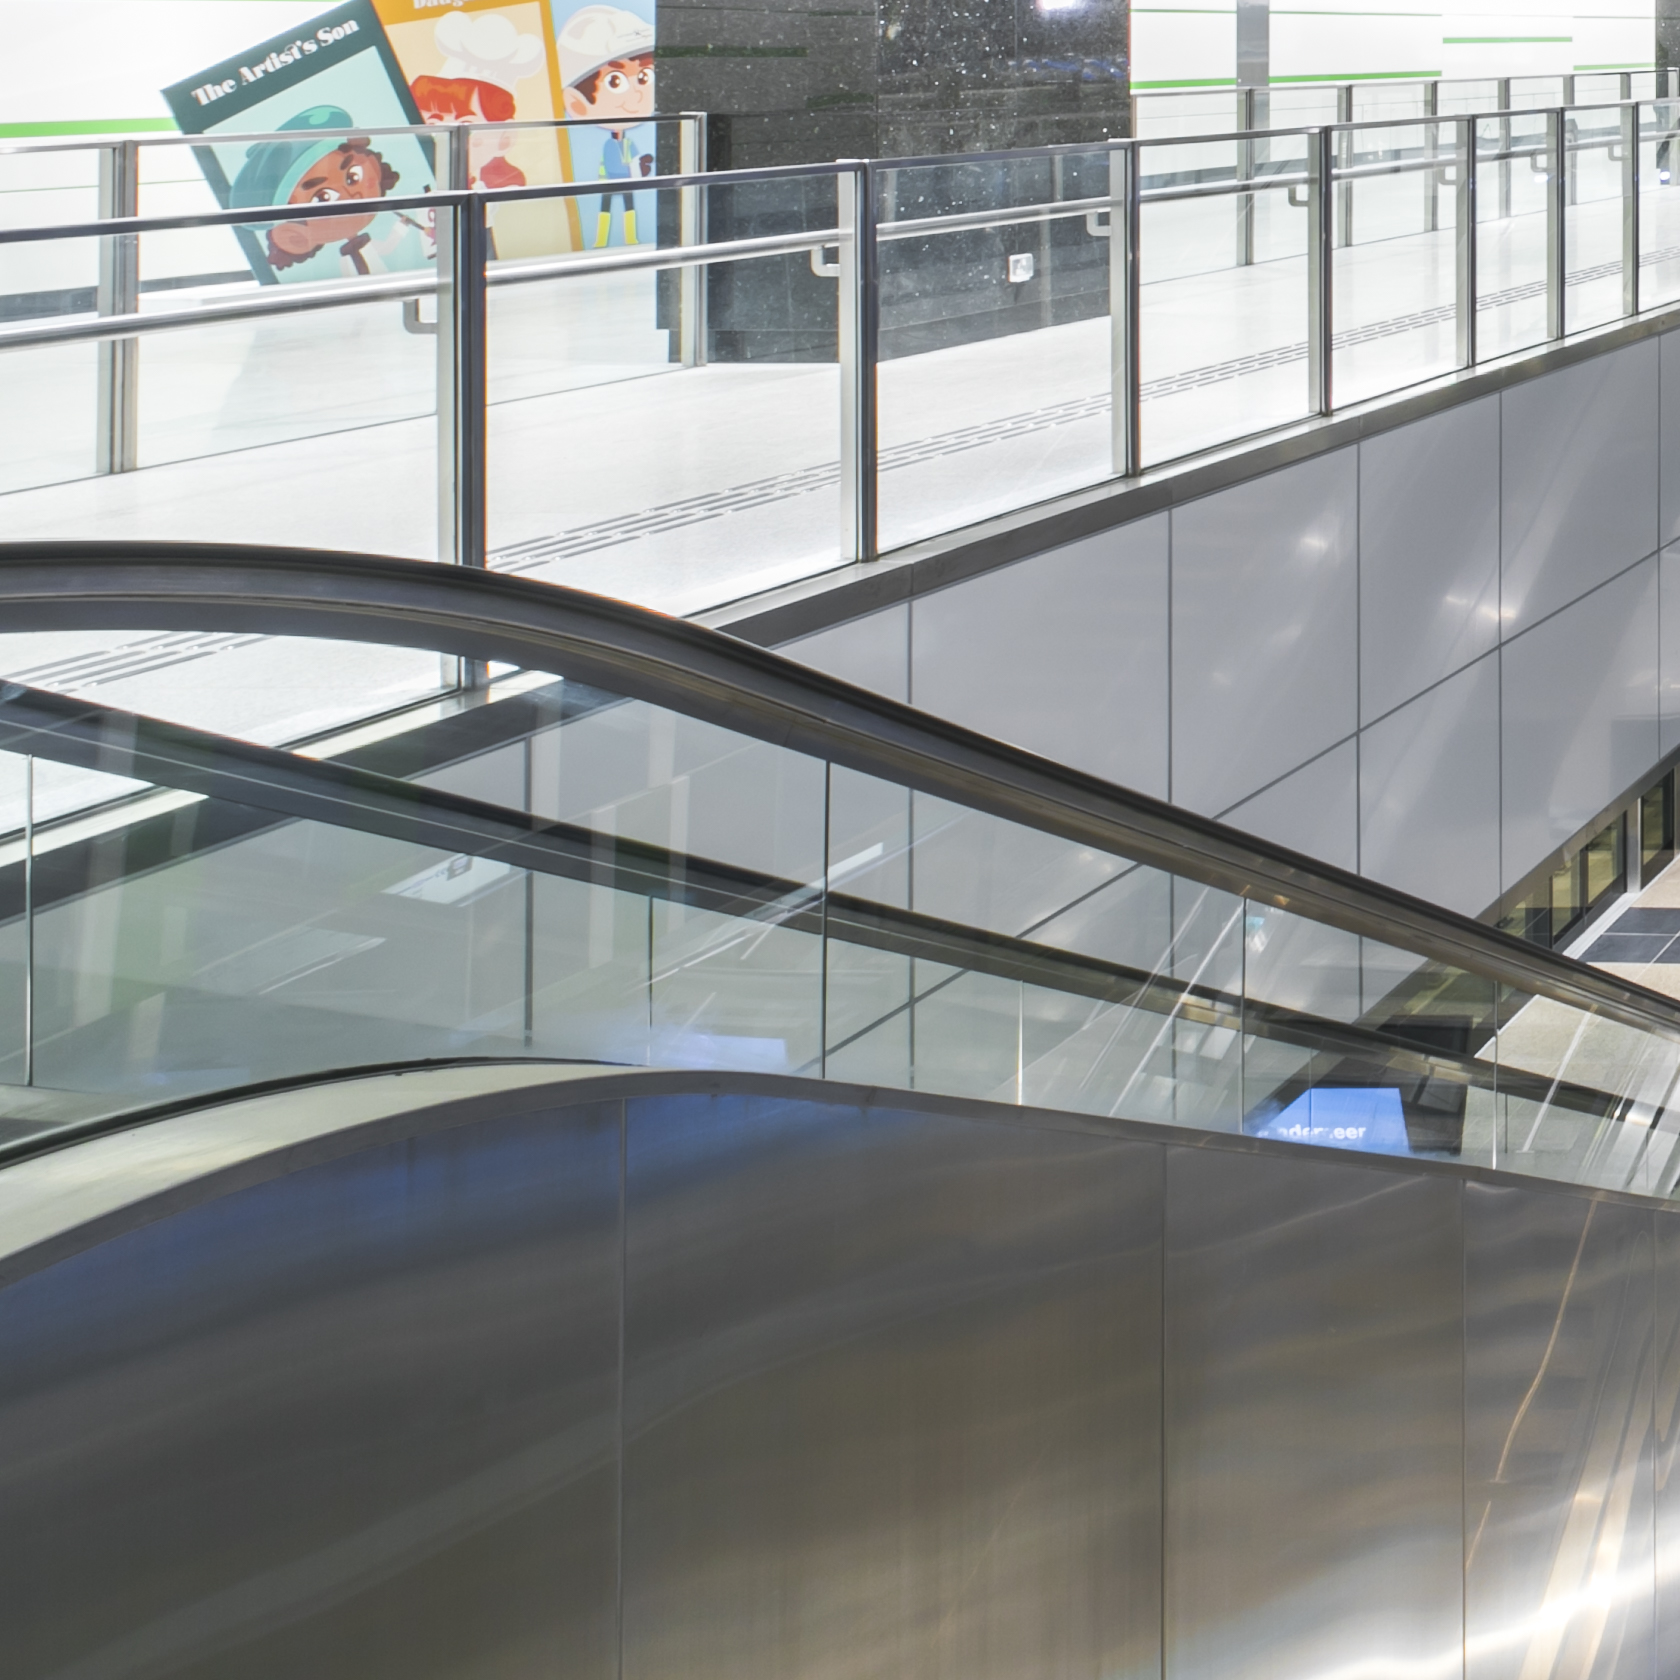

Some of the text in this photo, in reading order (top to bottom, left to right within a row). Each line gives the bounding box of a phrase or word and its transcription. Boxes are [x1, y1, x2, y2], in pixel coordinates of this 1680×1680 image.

[191, 19, 360, 106] The Artist's Son
